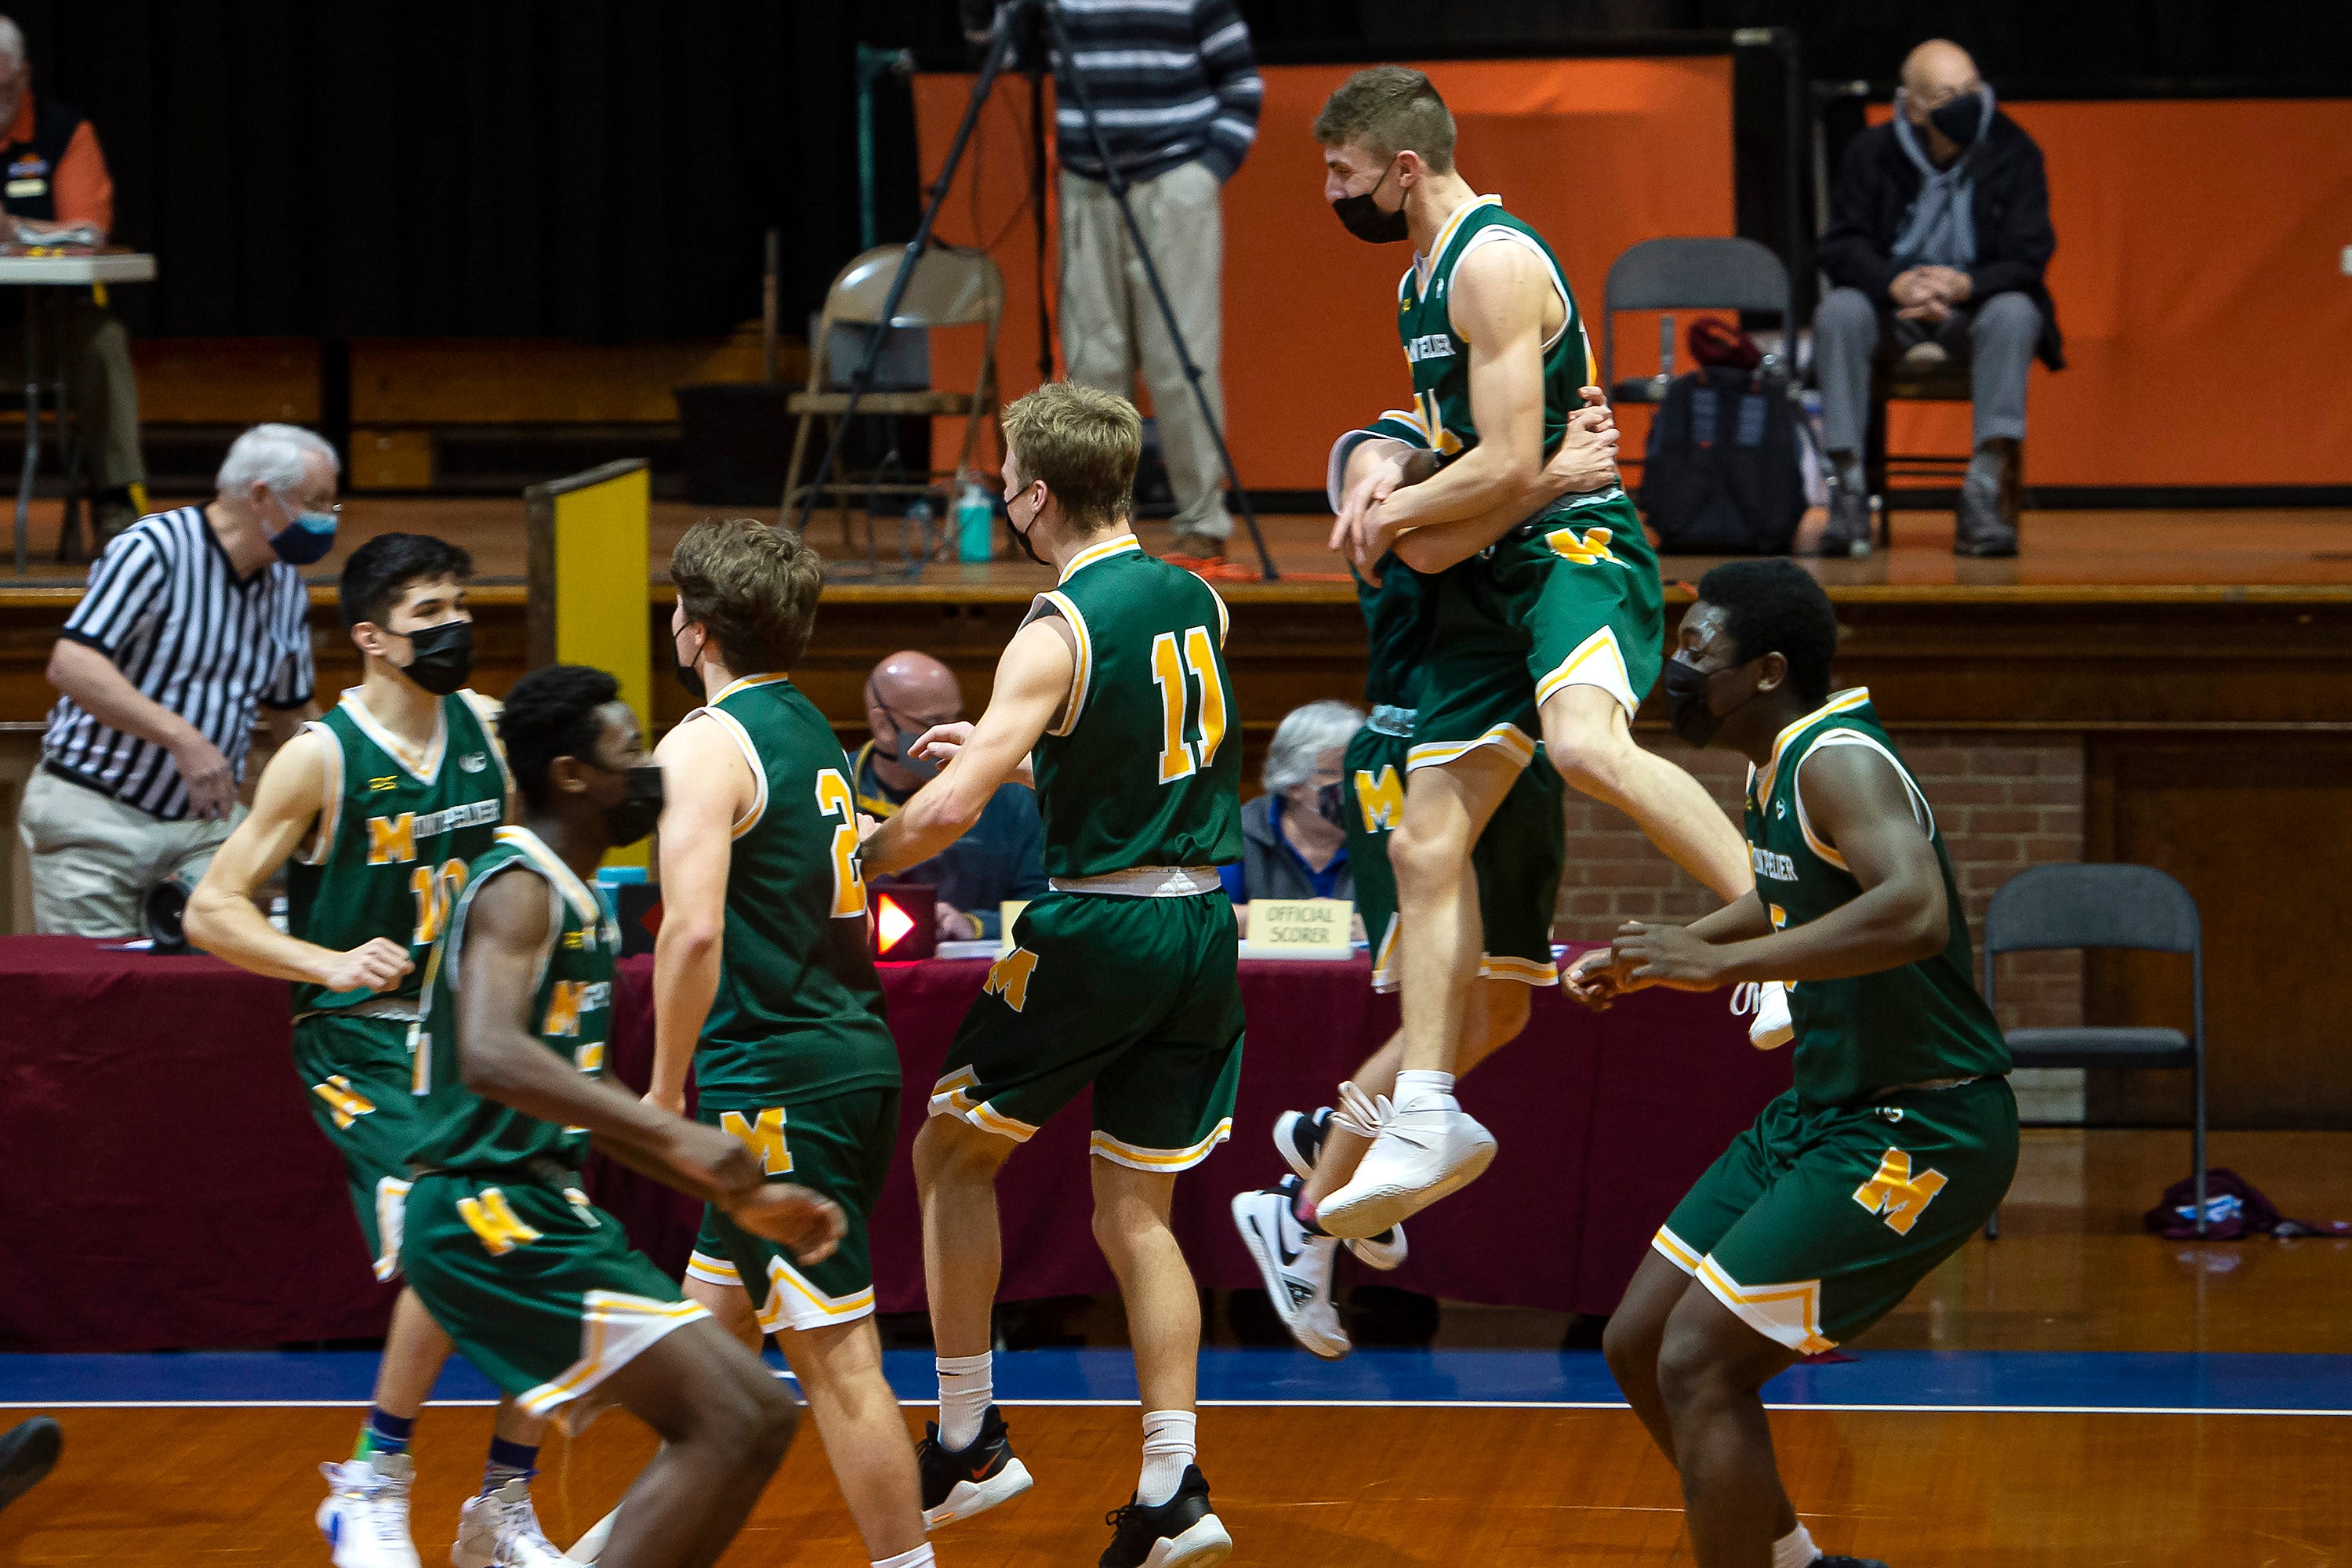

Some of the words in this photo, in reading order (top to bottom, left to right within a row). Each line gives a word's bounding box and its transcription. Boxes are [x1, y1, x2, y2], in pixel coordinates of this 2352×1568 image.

[1150, 625, 1227, 785] 11
[1353, 764, 1403, 834] M
[815, 768, 868, 919] 2
[1266, 906, 1336, 923] OFFICIAL
[1269, 927, 1330, 942] SCORER
[983, 946, 1039, 1013] M
[720, 1106, 794, 1176] M
[1852, 1146, 1949, 1236] M
